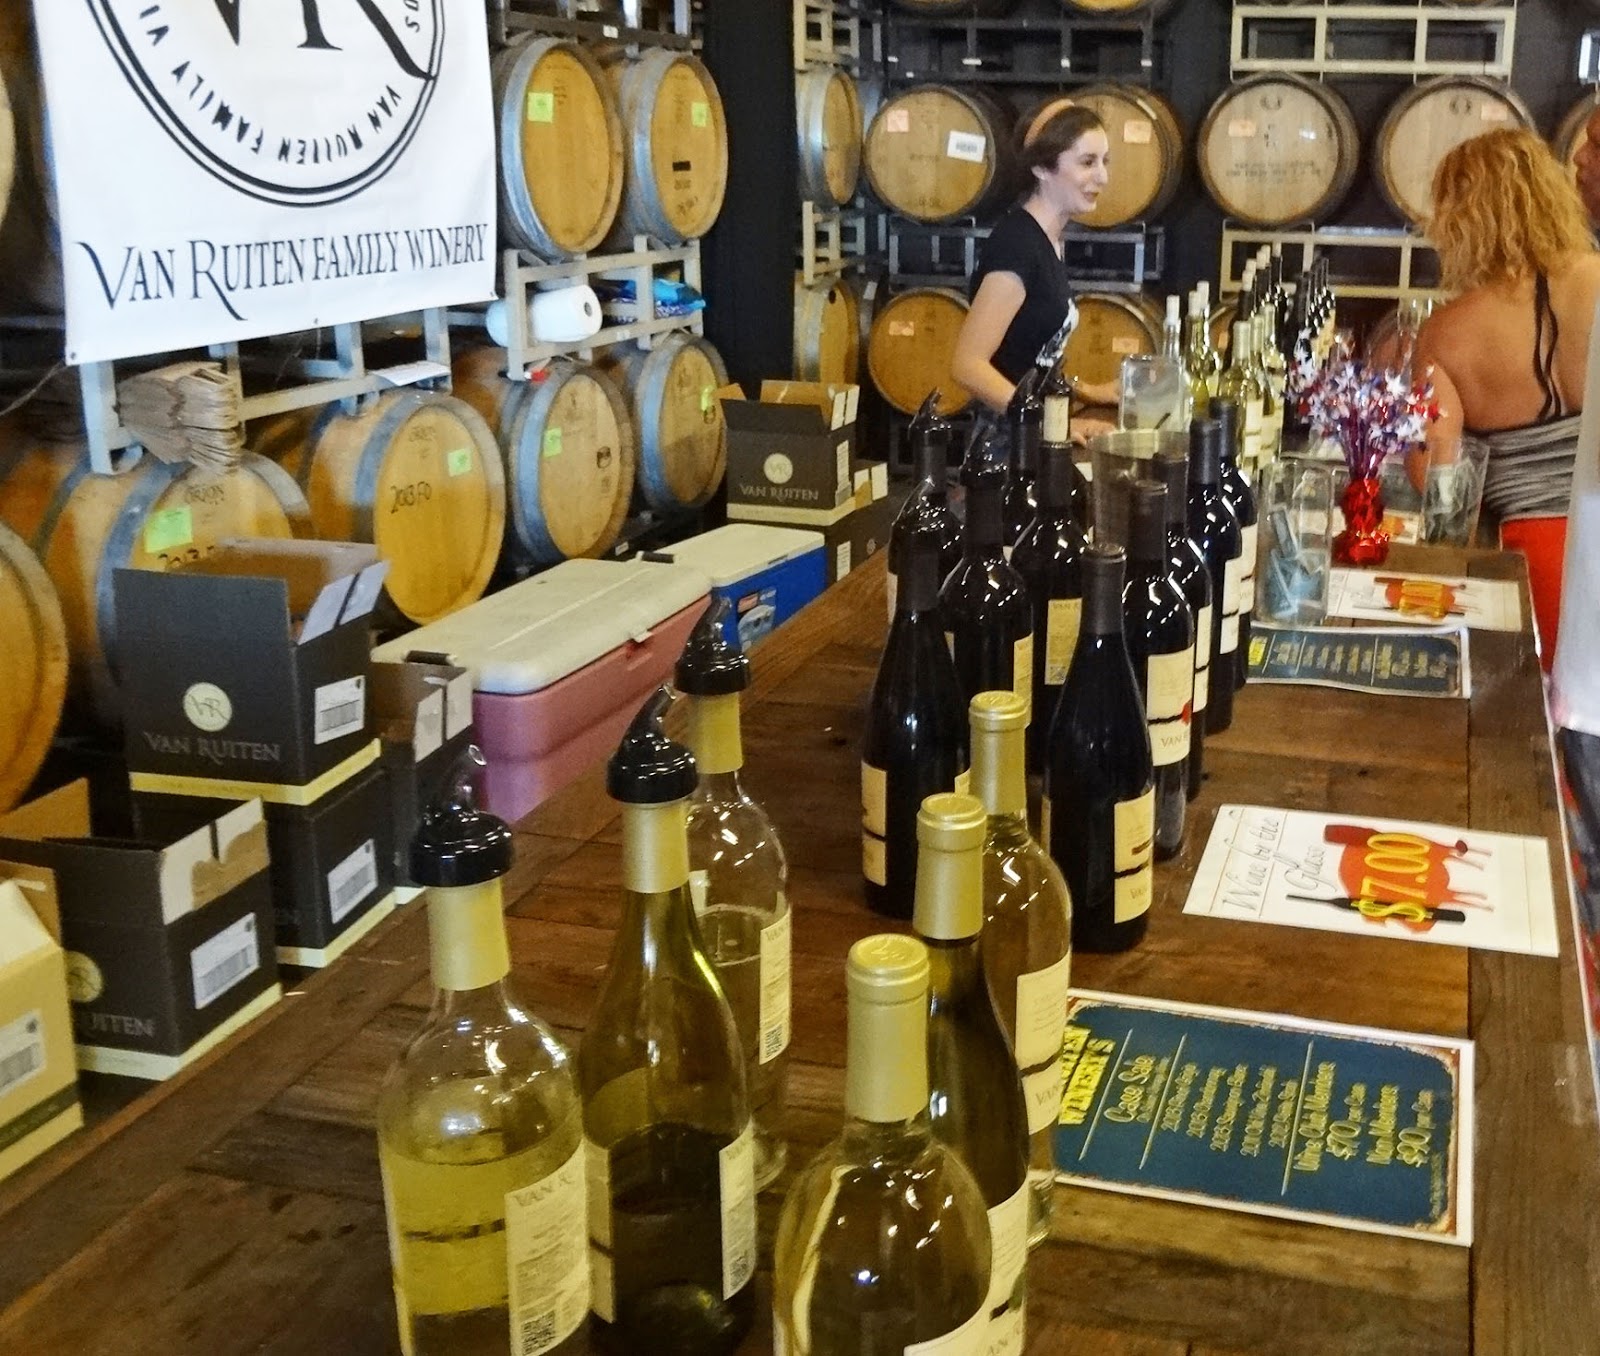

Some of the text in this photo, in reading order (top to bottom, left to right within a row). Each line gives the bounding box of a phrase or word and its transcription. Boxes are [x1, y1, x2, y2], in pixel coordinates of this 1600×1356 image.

[170, 60, 264, 155] FAMILY
[74, 223, 489, 322] VAN RUITEN FAMILY WINERY
[739, 483, 819, 503] VAN RUITEN
[143, 731, 282, 766] VAN RUITEN
[1350, 831, 1435, 924] $7.00
[1117, 1054, 1157, 1085] Sale
[1103, 1083, 1145, 1123] Case
